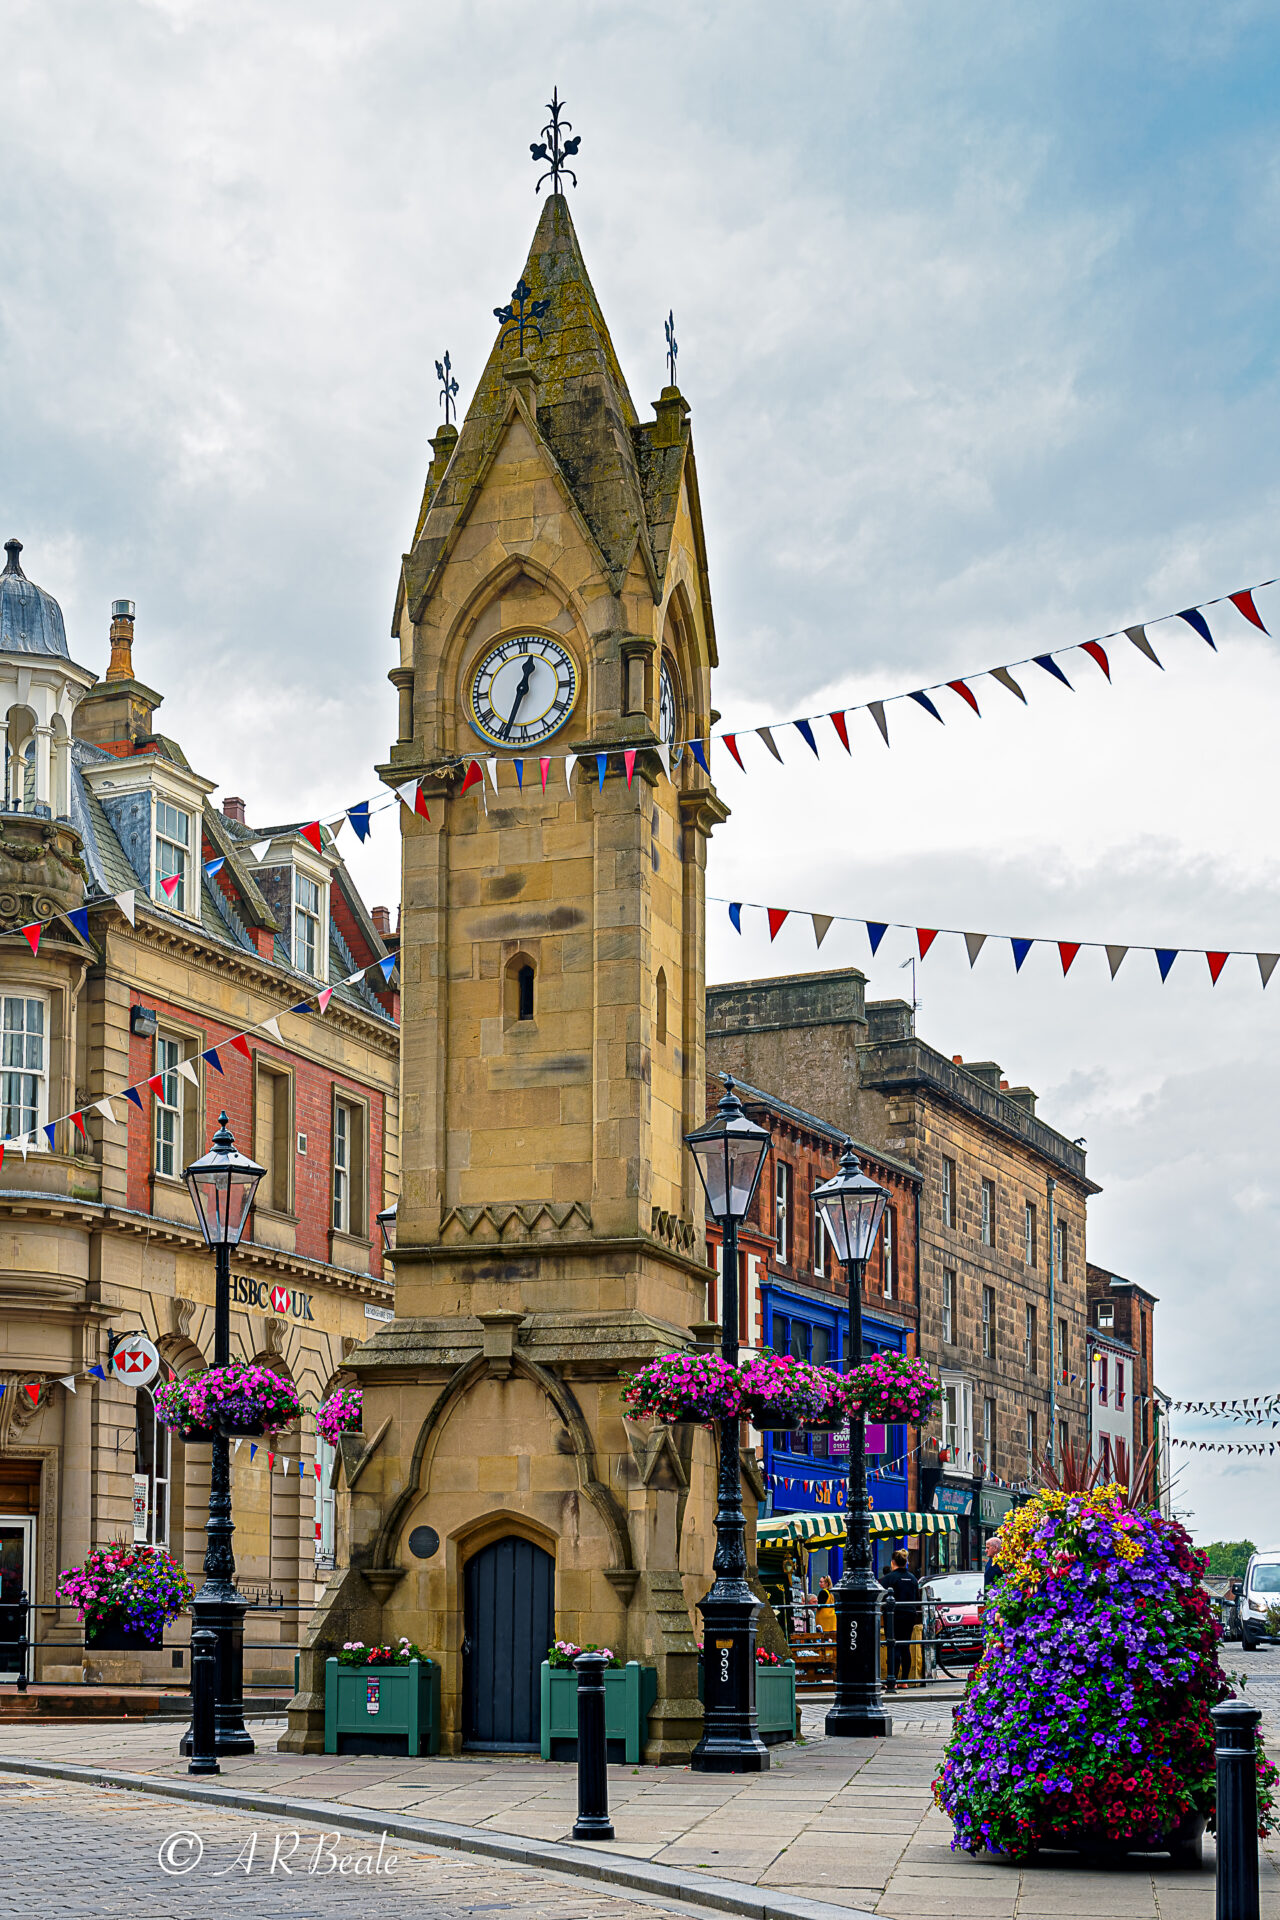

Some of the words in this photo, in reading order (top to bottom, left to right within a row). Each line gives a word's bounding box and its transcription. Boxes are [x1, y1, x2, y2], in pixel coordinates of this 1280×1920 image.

[229, 1274, 268, 1309] HSBC
[291, 1290, 314, 1320] UK
[720, 1648, 729, 1682] 993
